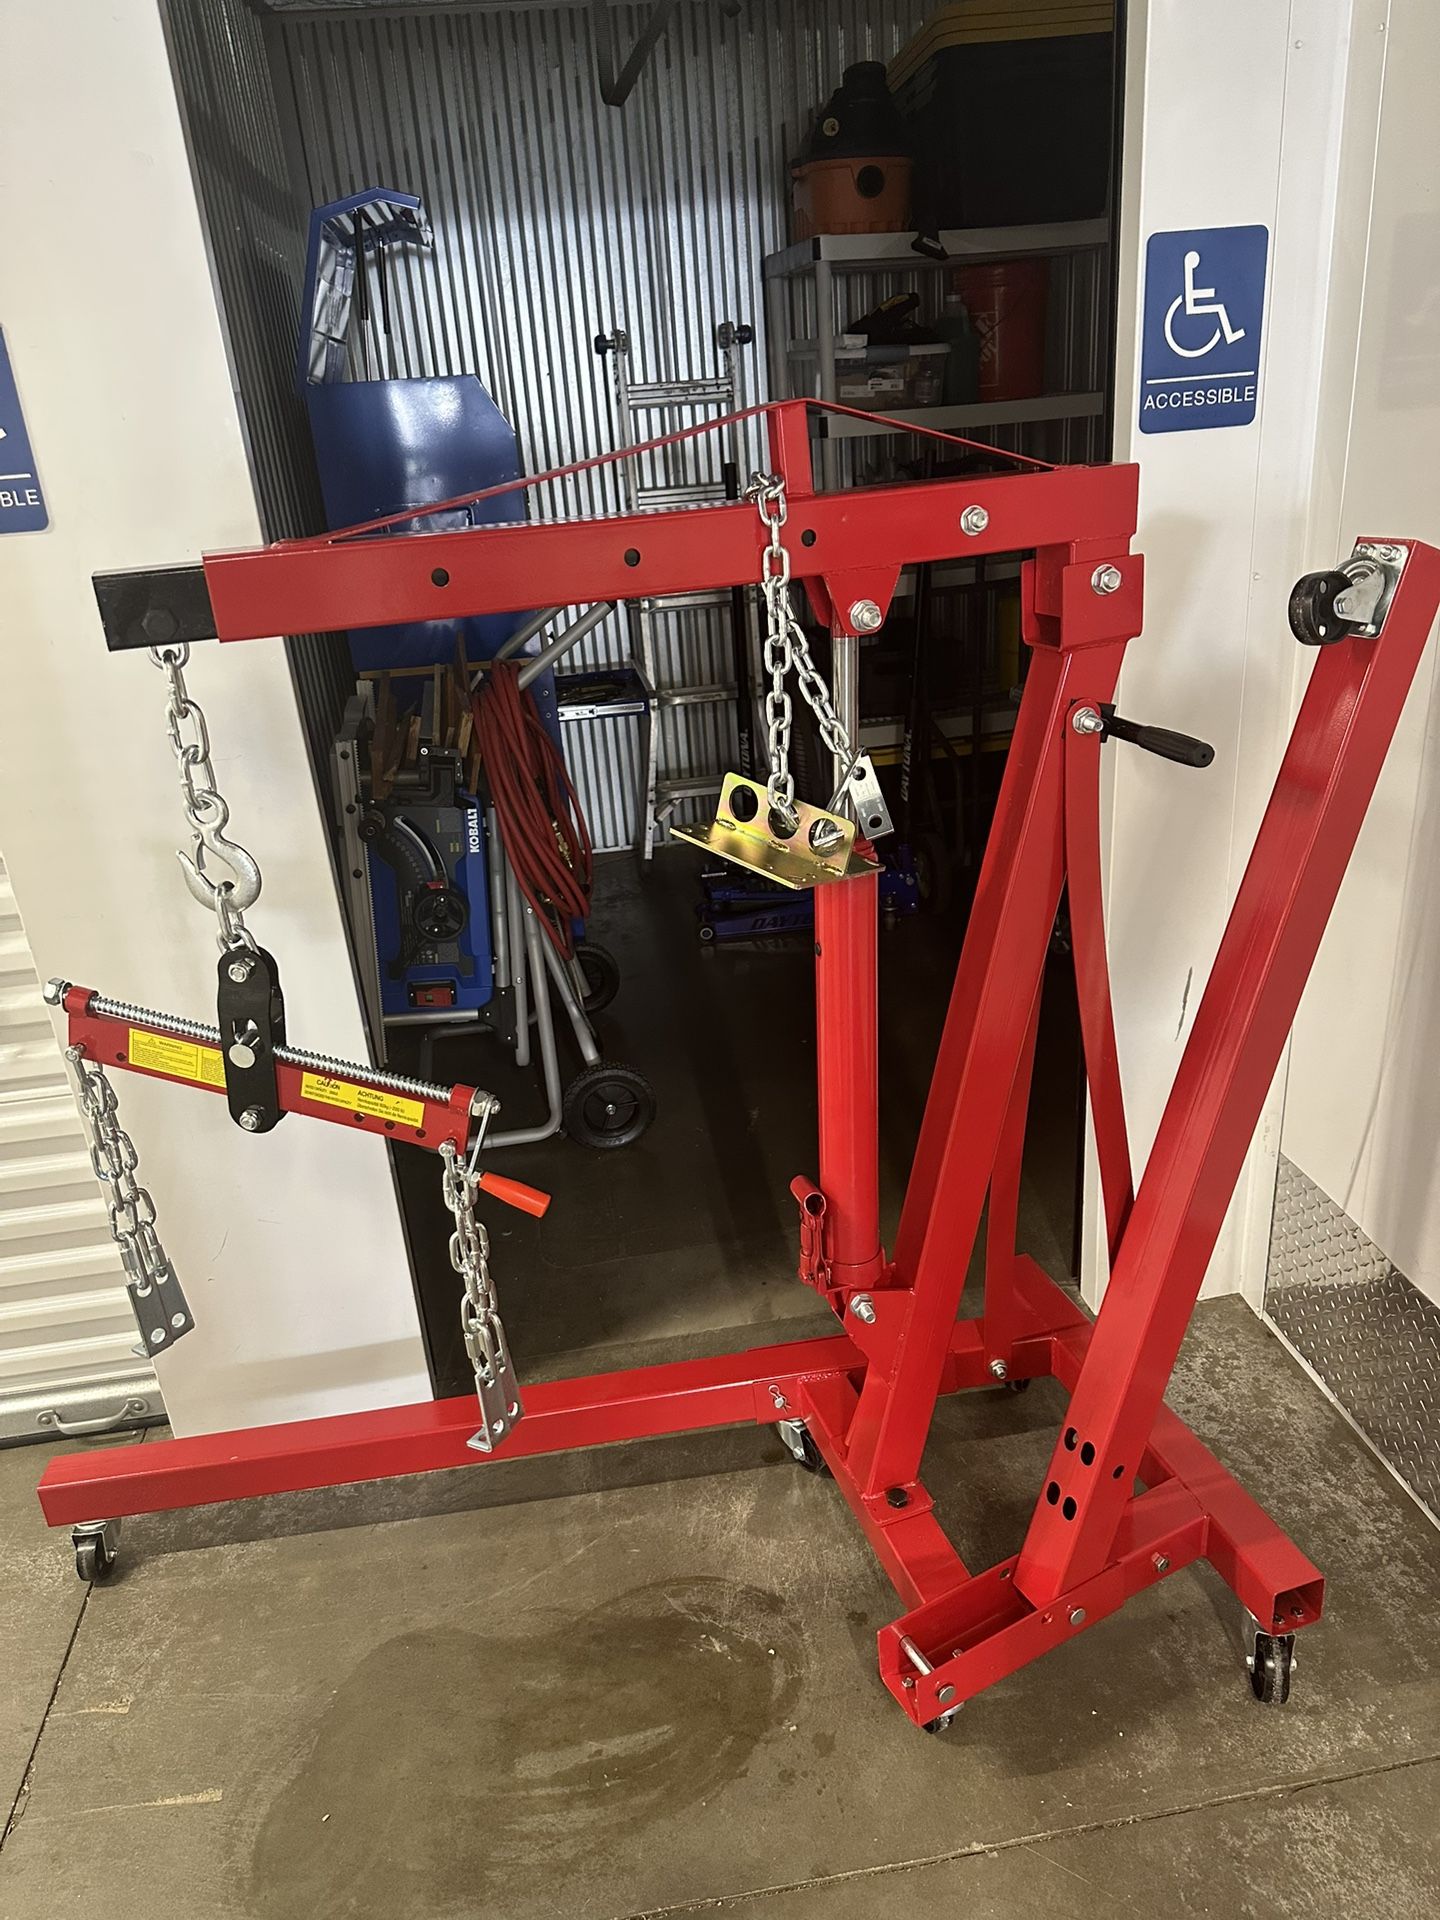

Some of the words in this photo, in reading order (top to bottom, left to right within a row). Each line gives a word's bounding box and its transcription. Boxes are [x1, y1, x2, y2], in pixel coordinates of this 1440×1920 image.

[1143, 386, 1256, 410] ACCESSIBLE
[467, 808, 480, 853] KOBALT
[357, 1089, 384, 1102] ACHTUNG
